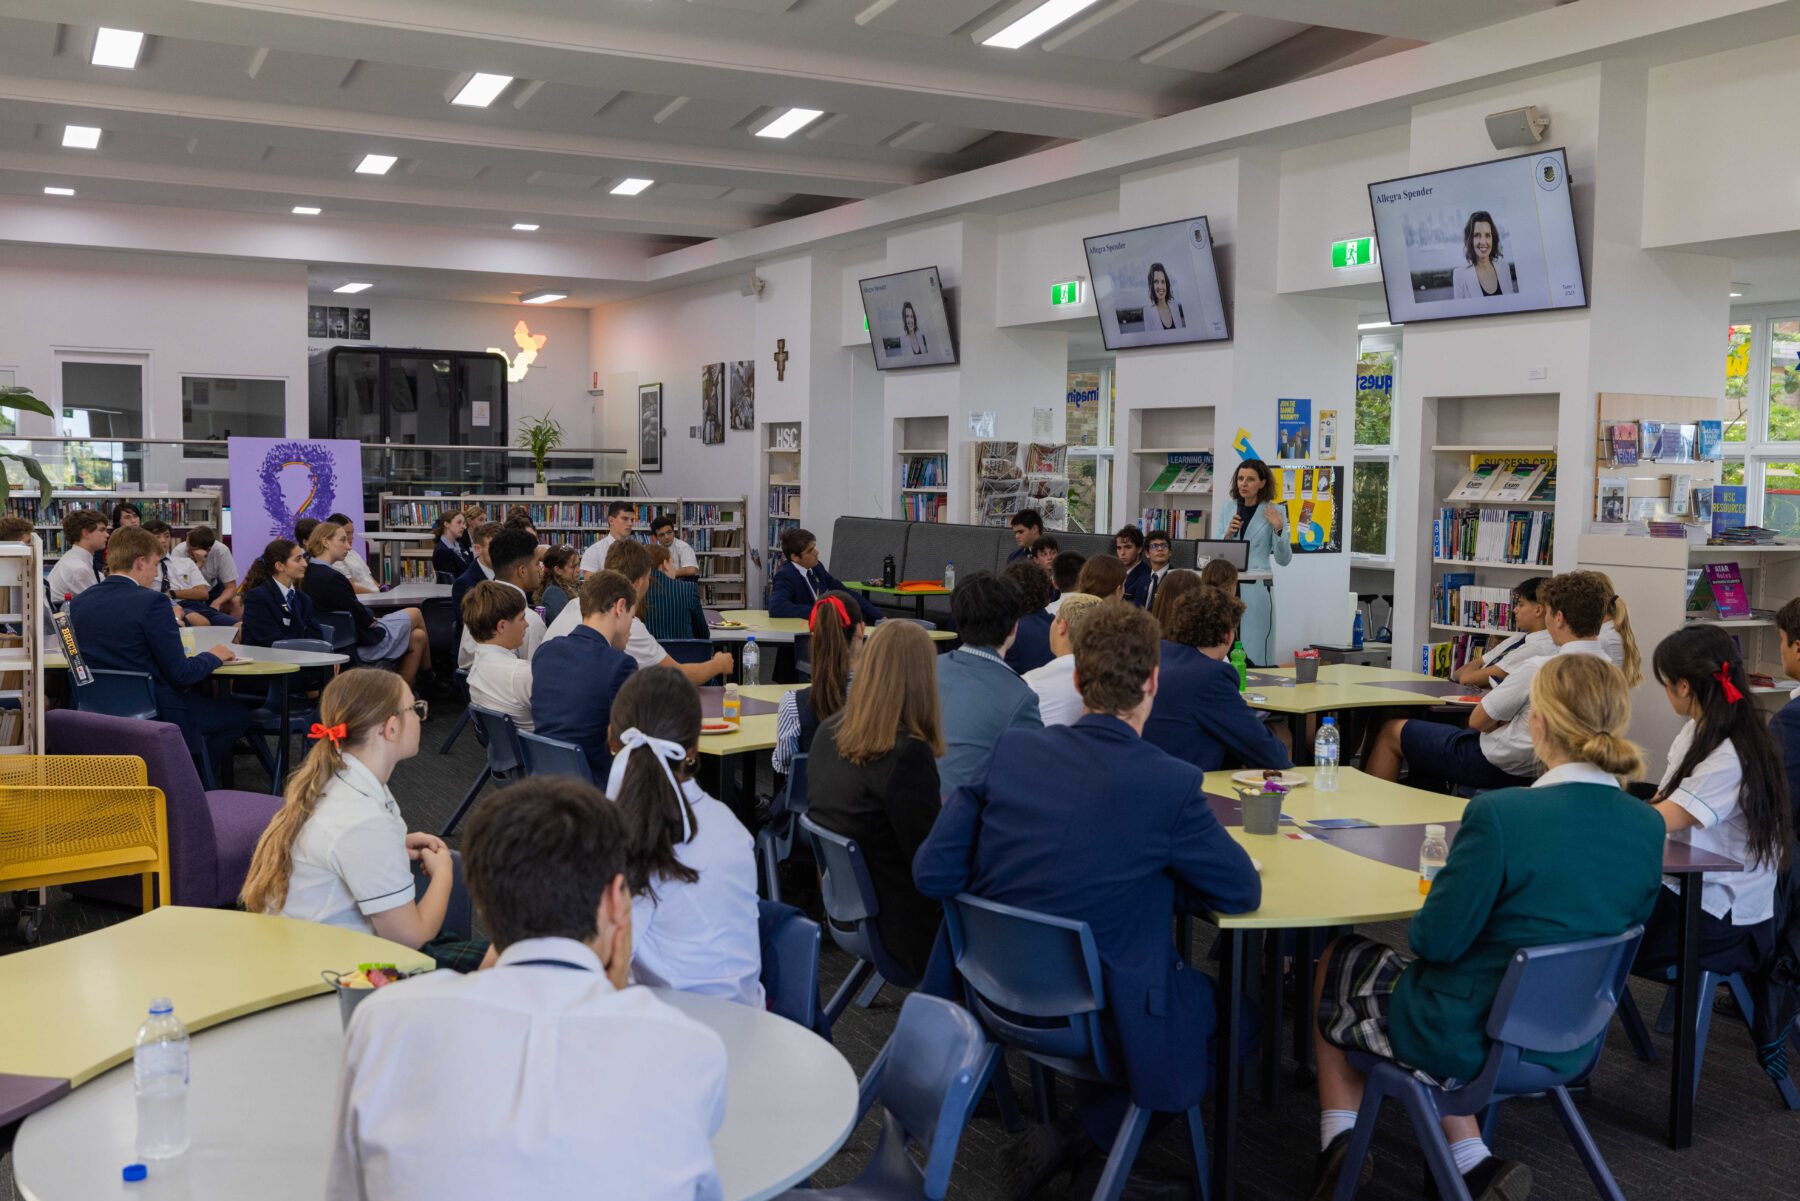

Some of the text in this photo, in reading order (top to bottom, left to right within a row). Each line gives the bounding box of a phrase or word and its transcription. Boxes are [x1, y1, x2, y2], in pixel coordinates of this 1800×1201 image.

[1376, 187, 1433, 204] Allegra Spender
[776, 427, 798, 448] HSC
[1170, 455, 1202, 464] LEARNING
[1484, 458, 1529, 467] SUCCESS
[1723, 492, 1736, 502] HSC
[1712, 503, 1746, 513] RESOURCES
[1714, 565, 1730, 573] ATAR
[61, 627, 78, 655] BRUCE
